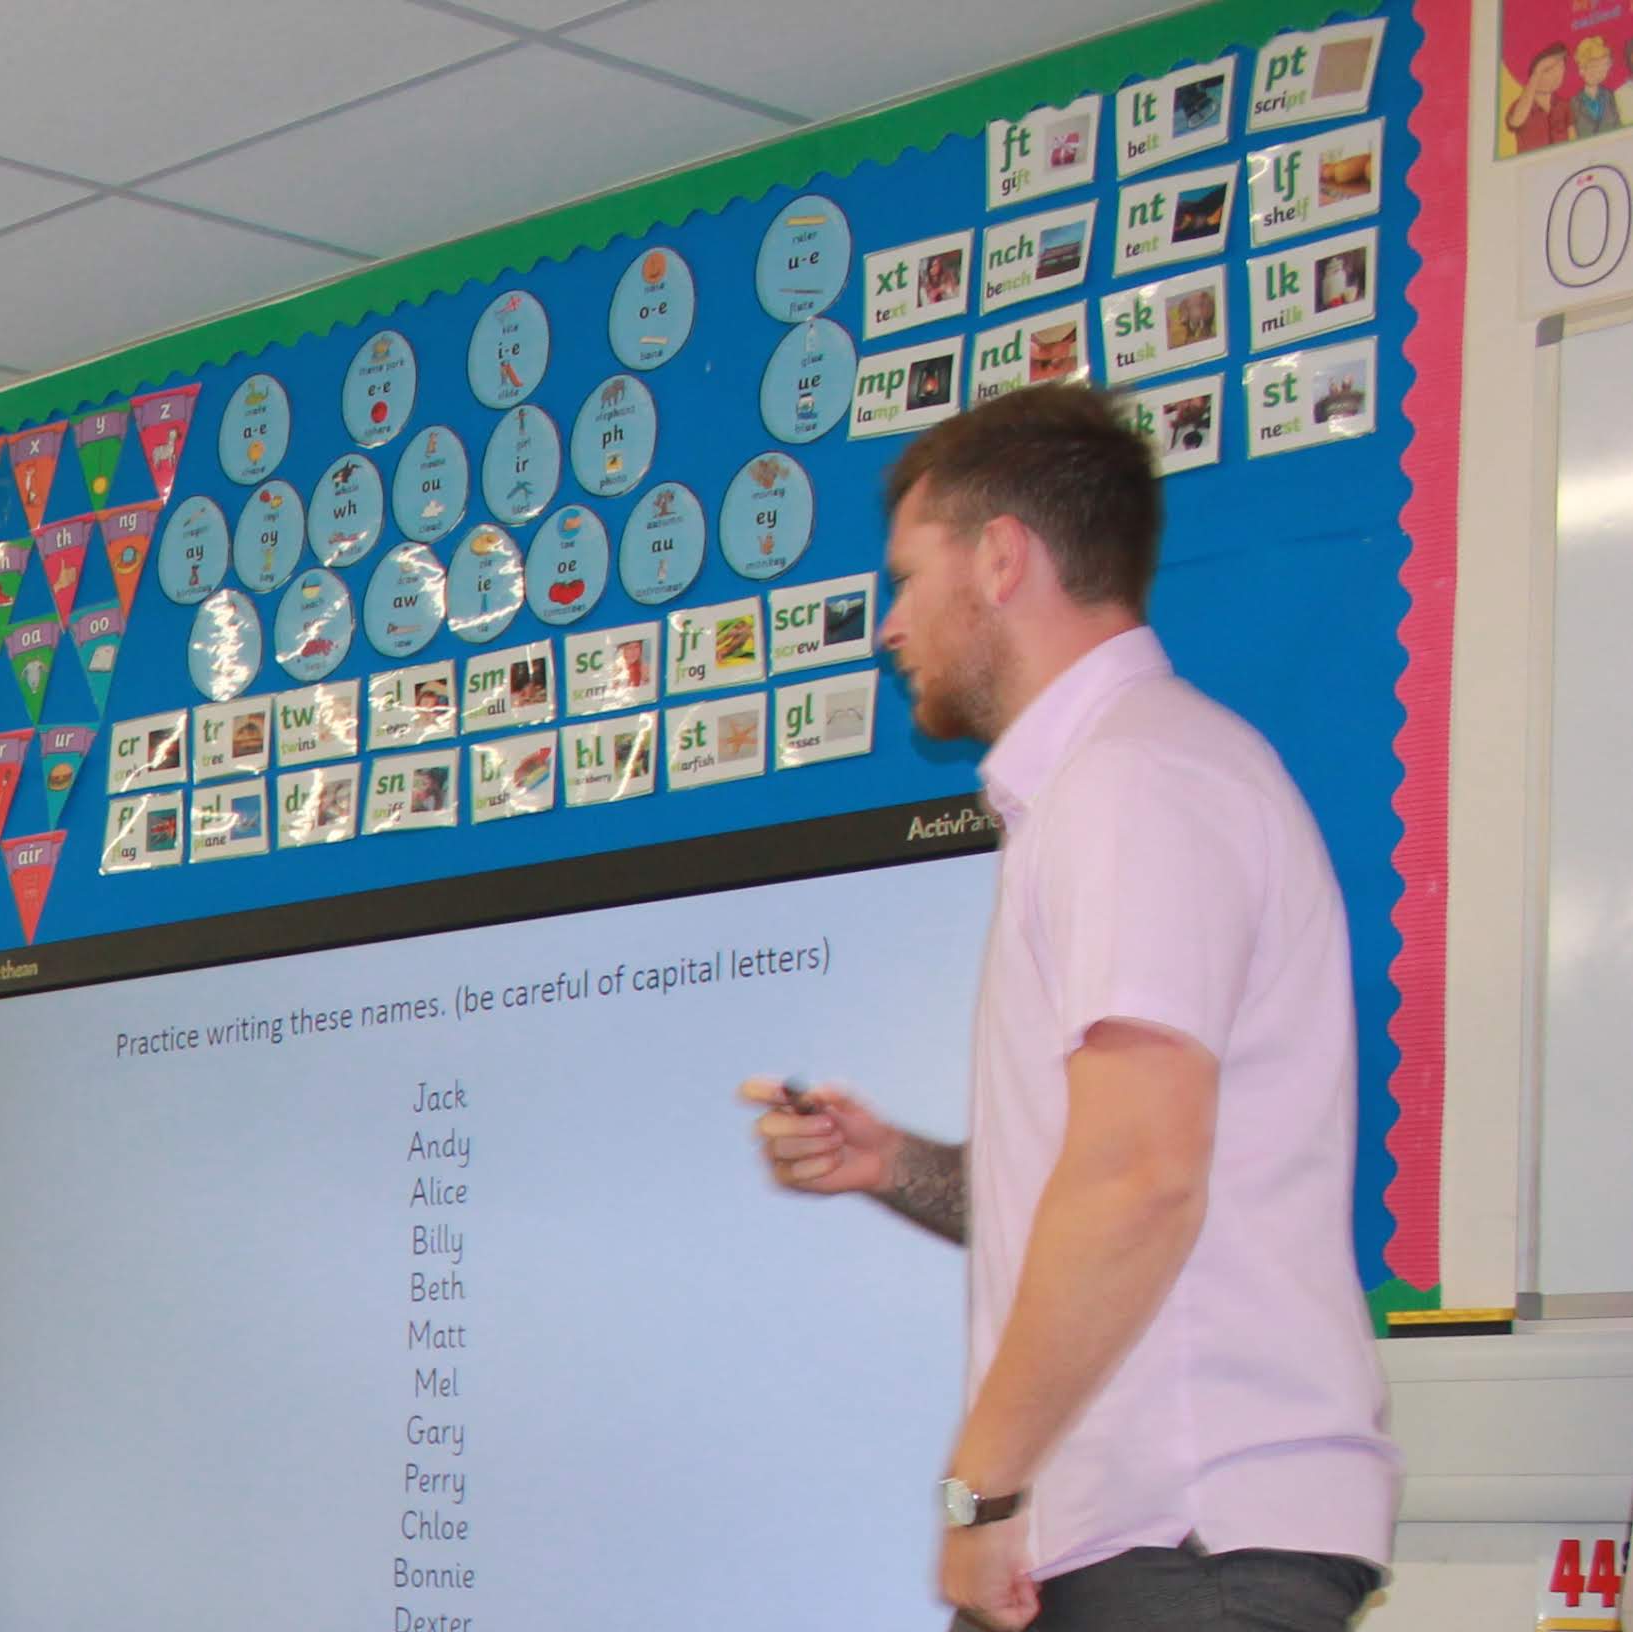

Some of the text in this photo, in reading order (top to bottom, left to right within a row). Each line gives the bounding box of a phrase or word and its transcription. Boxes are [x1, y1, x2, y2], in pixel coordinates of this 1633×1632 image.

[1265, 44, 1308, 93] pt
[1132, 92, 1158, 128] lt
[1254, 88, 1307, 115] script
[1000, 125, 1030, 172] ft
[1127, 133, 1160, 159] belt
[1002, 168, 1030, 195] gift
[1273, 150, 1302, 202] lf
[1128, 192, 1167, 229] nt
[1263, 198, 1310, 228] shelf
[988, 234, 1033, 270] nch
[1125, 234, 1160, 258] tent
[788, 251, 820, 270] u-e
[875, 260, 909, 297] xt
[986, 270, 1032, 298] bench
[1266, 261, 1300, 301] lk
[639, 301, 668, 319] o-e
[876, 302, 907, 323] text
[1115, 298, 1155, 338] sk
[1261, 304, 1303, 334] milk
[498, 342, 520, 360] i-e
[980, 328, 1023, 371] nd
[1116, 343, 1157, 368] tusk
[367, 381, 392, 397] e-e
[798, 373, 821, 391] ue
[857, 366, 906, 399] mp
[1262, 371, 1298, 409] st
[160, 402, 172, 420] z
[857, 401, 900, 423] lamp
[96, 417, 106, 434] y
[243, 423, 268, 439] a-e
[602, 424, 624, 449] ph
[1261, 410, 1302, 440] nest
[516, 456, 529, 473] ir
[422, 478, 442, 493] ou
[119, 513, 137, 531] ng
[333, 500, 358, 519] wh
[756, 509, 777, 528] ey
[56, 528, 72, 549] th
[261, 531, 279, 547] oy
[651, 537, 674, 554] au
[186, 544, 204, 560] ay
[558, 558, 577, 574] oe
[393, 593, 418, 609] aw
[90, 617, 109, 634] oo
[774, 602, 821, 632] scr
[22, 630, 40, 646] oa
[676, 619, 704, 662] fr
[774, 640, 820, 658] screw
[576, 650, 603, 674] sc
[468, 668, 505, 693] sm
[280, 705, 315, 730] tw
[787, 693, 814, 738] gl
[54, 730, 75, 748] ur
[118, 735, 141, 757] cr
[680, 720, 707, 750] st
[376, 772, 405, 795] sn
[17, 845, 43, 865] air
[116, 936, 830, 1058] Practice writing these names. (be careful of capital letters)
[412, 1078, 467, 1113] Jack
[407, 1127, 470, 1169] Andy
[409, 1175, 468, 1209] Alice
[412, 1224, 463, 1265] Billy
[410, 1270, 466, 1302] Beth
[407, 1320, 466, 1351] Matt
[414, 1367, 459, 1399] Mel
[406, 1414, 465, 1456] Gary
[405, 1463, 465, 1505] Perry
[401, 1509, 469, 1541] Chloe
[393, 1557, 475, 1589] Bonnie
[1549, 1539, 1622, 1608] 44
